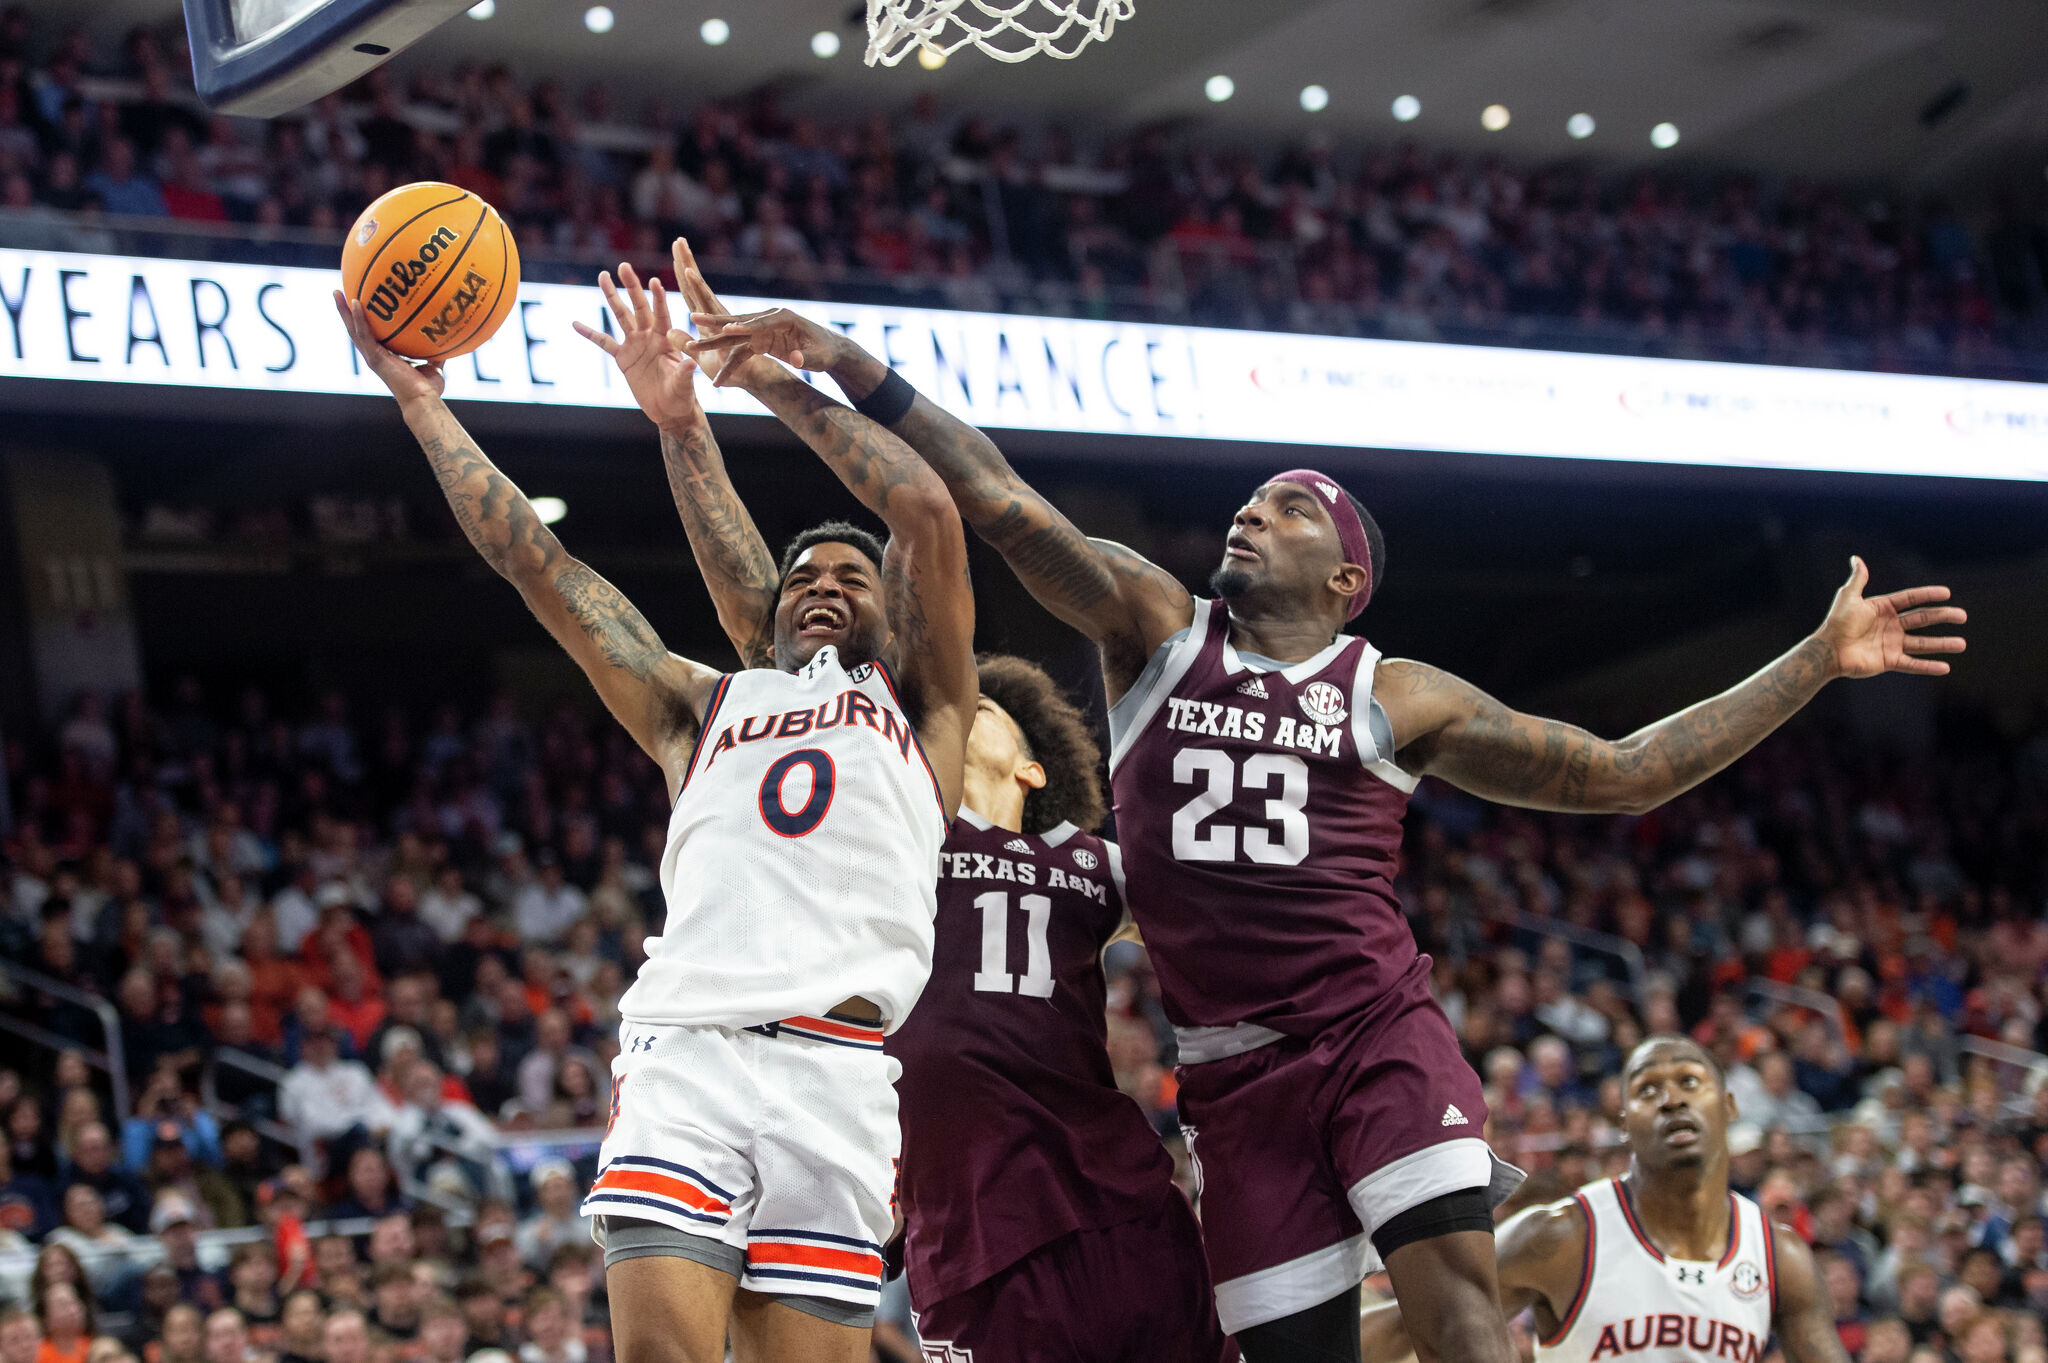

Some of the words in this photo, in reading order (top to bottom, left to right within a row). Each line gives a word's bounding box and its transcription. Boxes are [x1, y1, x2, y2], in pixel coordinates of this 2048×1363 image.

[366, 226, 459, 322] Wilson
[420, 270, 488, 343] NCAA
[0, 267, 296, 372] YEARS
[846, 663, 873, 683] EC
[1236, 685, 1269, 700] adidas
[1308, 684, 1341, 715] SEC
[704, 690, 911, 773] AUBURN
[1167, 697, 1266, 742] TEXAS
[1273, 716, 1343, 758] A&M
[758, 748, 836, 838] 0
[1172, 747, 1310, 866] 23
[937, 852, 1036, 886] TEXAS
[1048, 867, 1107, 906] A&M
[1074, 851, 1097, 870] SEC
[973, 891, 1056, 998] 11
[1441, 1116, 1469, 1127] adidas
